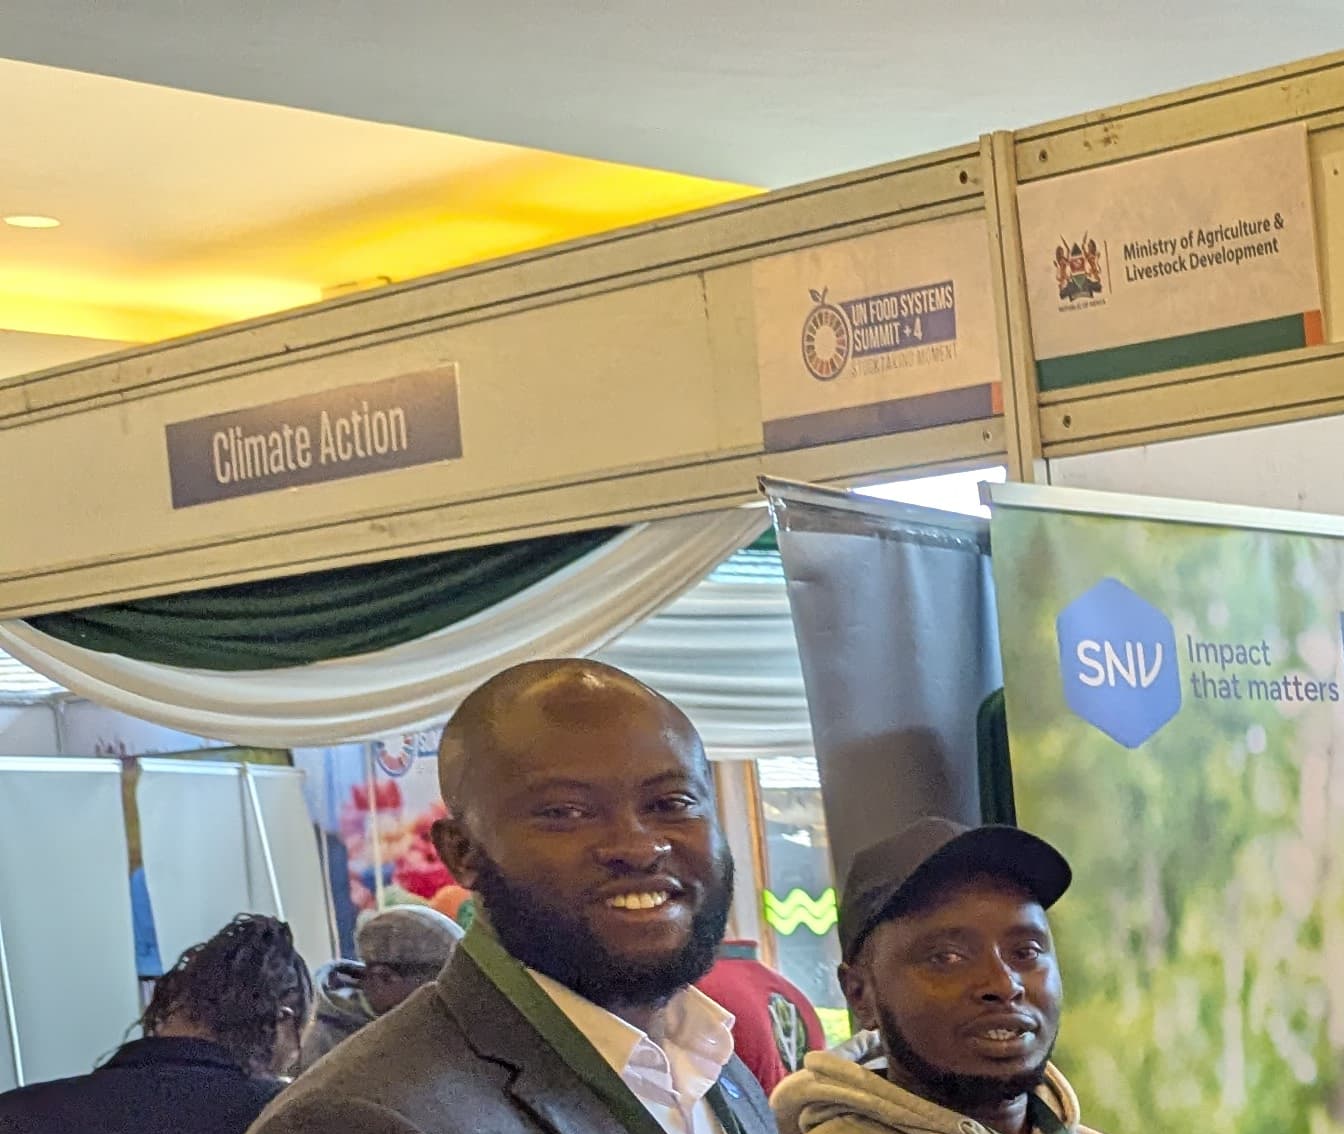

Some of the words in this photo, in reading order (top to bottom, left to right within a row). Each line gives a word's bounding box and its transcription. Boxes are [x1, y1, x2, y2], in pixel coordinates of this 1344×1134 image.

[1123, 239, 1177, 261] Ministry
[1180, 230, 1194, 248] of
[1196, 219, 1271, 249] Agriculture
[1273, 212, 1285, 230] &
[1125, 256, 1187, 283] Livestock
[1189, 238, 1279, 270] Development
[851, 301, 867, 326] UN
[869, 297, 899, 323] FOOD
[900, 285, 954, 318] SYSTEMS
[853, 322, 901, 352] SUMMIT
[913, 317, 923, 341] 4
[212, 424, 311, 485] Climate
[319, 401, 408, 465] Action
[1075, 639, 1163, 689] SNV
[1187, 634, 1272, 671] Impact
[1190, 671, 1241, 700] that
[1247, 675, 1340, 702] matters
